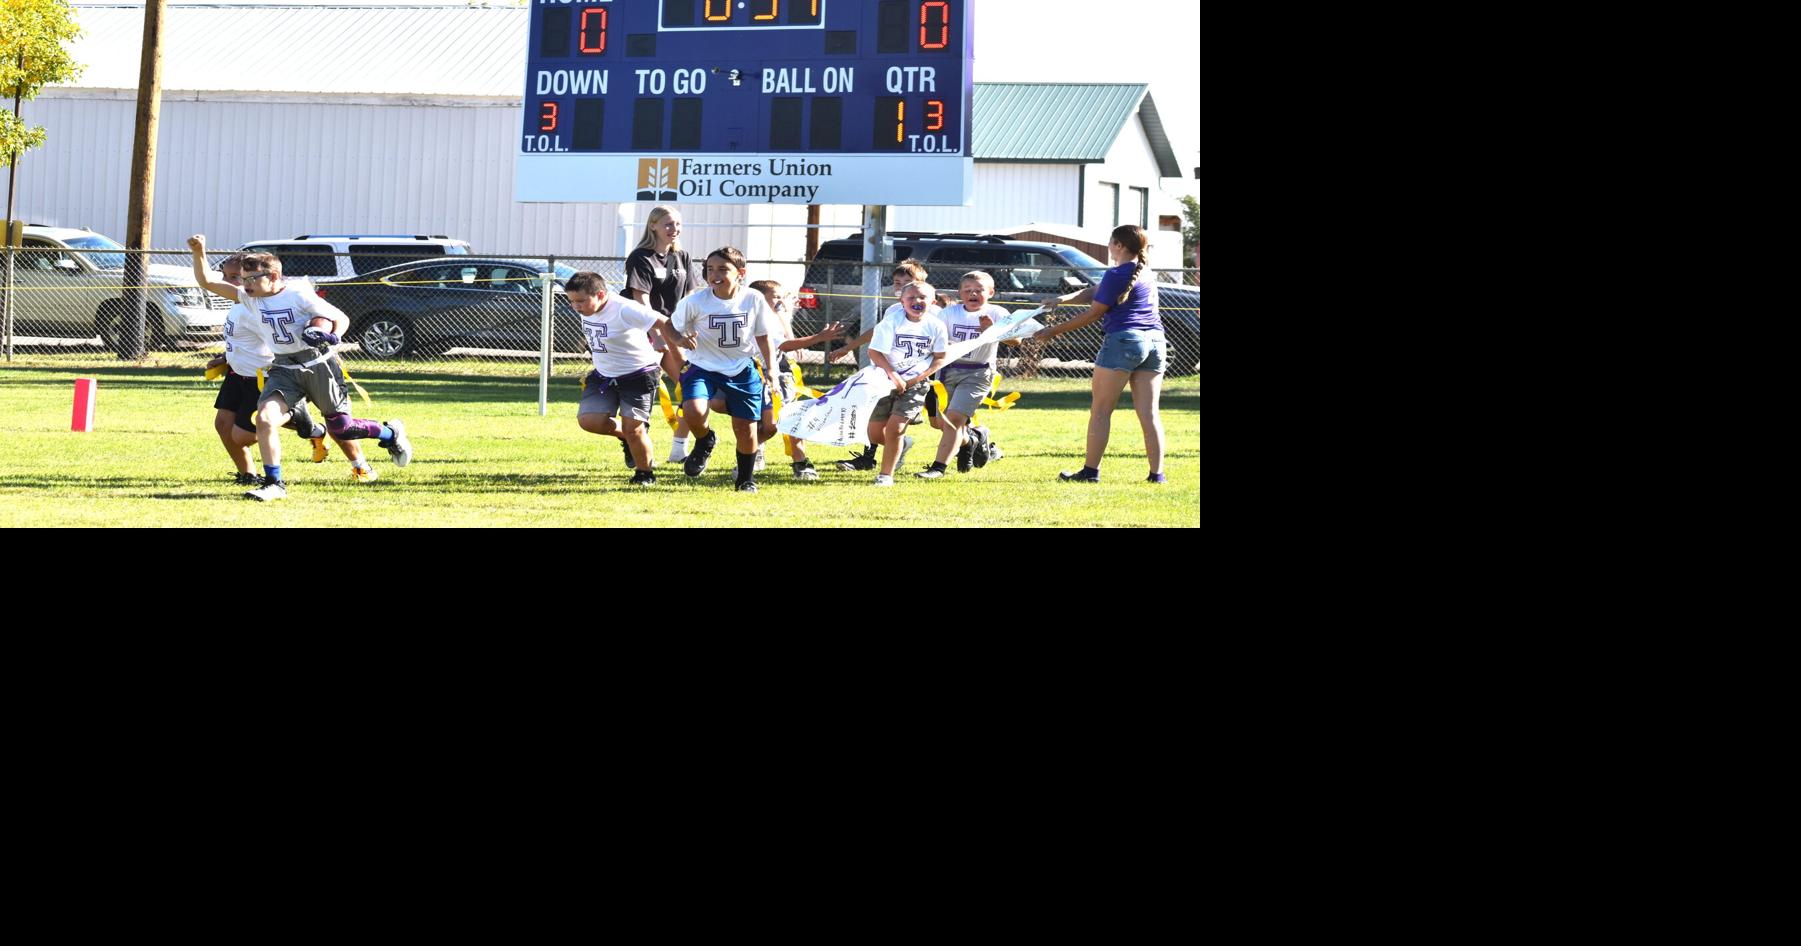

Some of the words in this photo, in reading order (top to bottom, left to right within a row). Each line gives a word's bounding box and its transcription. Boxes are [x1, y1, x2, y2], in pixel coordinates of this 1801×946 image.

[579, 8, 607, 53] 0
[919, 1, 949, 49] 0
[536, 69, 609, 95] DOWN
[635, 68, 666, 94] TO
[672, 68, 707, 94] GO
[762, 67, 816, 94] BALL
[822, 67, 854, 93] ON
[886, 66, 936, 94] QTR
[540, 102, 558, 131] 3
[896, 100, 905, 142] 1
[926, 100, 944, 130] 3
[524, 135, 569, 152] T.O.L.
[908, 135, 958, 153] T.O.L.
[681, 158, 762, 176] Farmers
[768, 158, 832, 176] Union
[679, 179, 712, 197] Oil
[719, 179, 819, 203] Company
[260, 308, 295, 345] T
[582, 319, 608, 353] T
[709, 312, 748, 348] T
